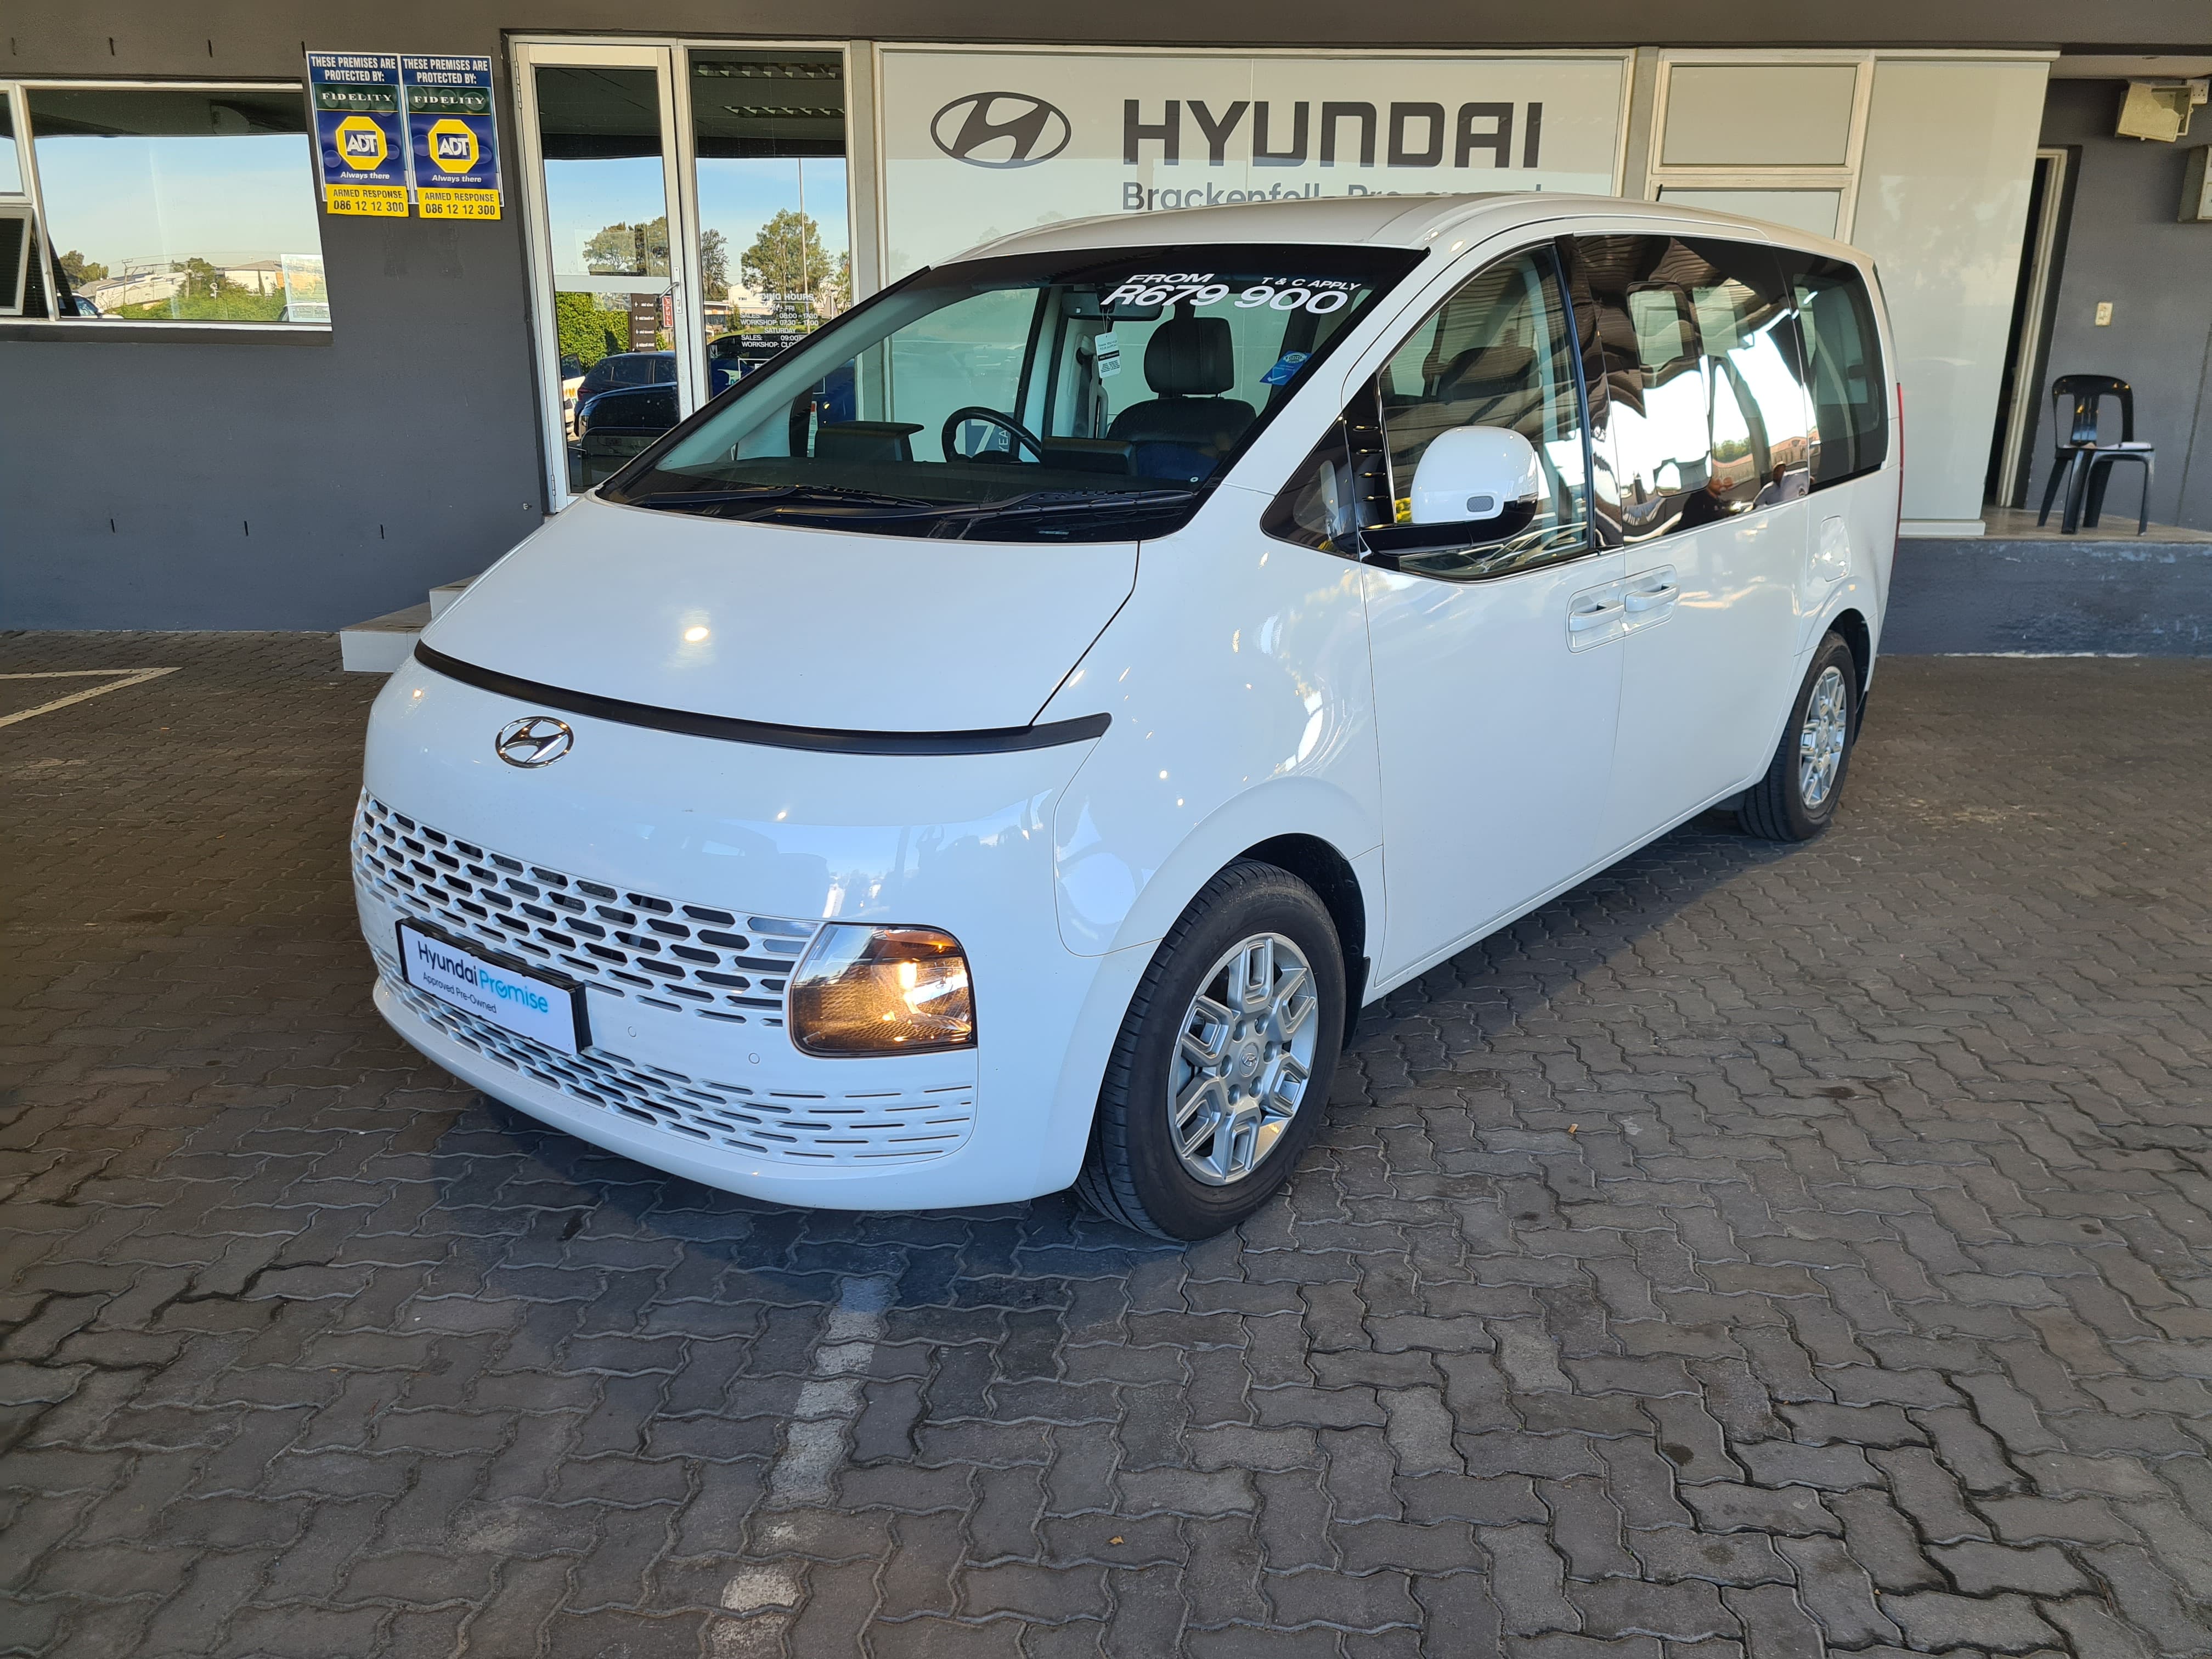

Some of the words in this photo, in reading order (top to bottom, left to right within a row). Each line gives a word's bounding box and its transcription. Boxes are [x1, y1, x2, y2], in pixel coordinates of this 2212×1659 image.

[311, 57, 336, 67] THESE
[338, 57, 378, 69] PREMISES
[381, 59, 396, 69] ARE
[403, 59, 428, 70] THESE
[431, 59, 470, 71] PREMISES
[472, 61, 488, 71] ARE
[325, 71, 370, 81] PROTECTED
[373, 72, 385, 82] BY:
[416, 73, 462, 83] PROTECTED
[465, 75, 477, 84] BY:
[322, 93, 393, 101] FIDELITY
[414, 96, 485, 105] FIDELITY
[1124, 100, 1543, 168] HYUNDAI
[347, 134, 377, 153] ADT
[438, 138, 470, 156] ADT
[341, 171, 368, 180] Always
[432, 174, 460, 183] Always
[363, 190, 403, 199] RESPONSE
[425, 193, 452, 201] ARMED
[455, 193, 494, 202] RESPONSE
[334, 200, 351, 210] 086
[356, 201, 366, 211] 12
[371, 202, 382, 211] 12
[386, 202, 404, 212] 300
[426, 204, 443, 213] 086
[447, 205, 458, 214] 12
[462, 205, 473, 215] 12
[477, 205, 495, 215] 300
[1125, 273, 1215, 283] FROM
[1262, 277, 1273, 285] T
[1291, 279, 1307, 287] C
[1310, 280, 1362, 292] APPLY
[1099, 284, 1230, 306] R679
[1234, 285, 1348, 314] 900
[999, 427, 1008, 452] YEA
[424, 972, 455, 995] Approved
[456, 987, 497, 1014] Pre-Owned
